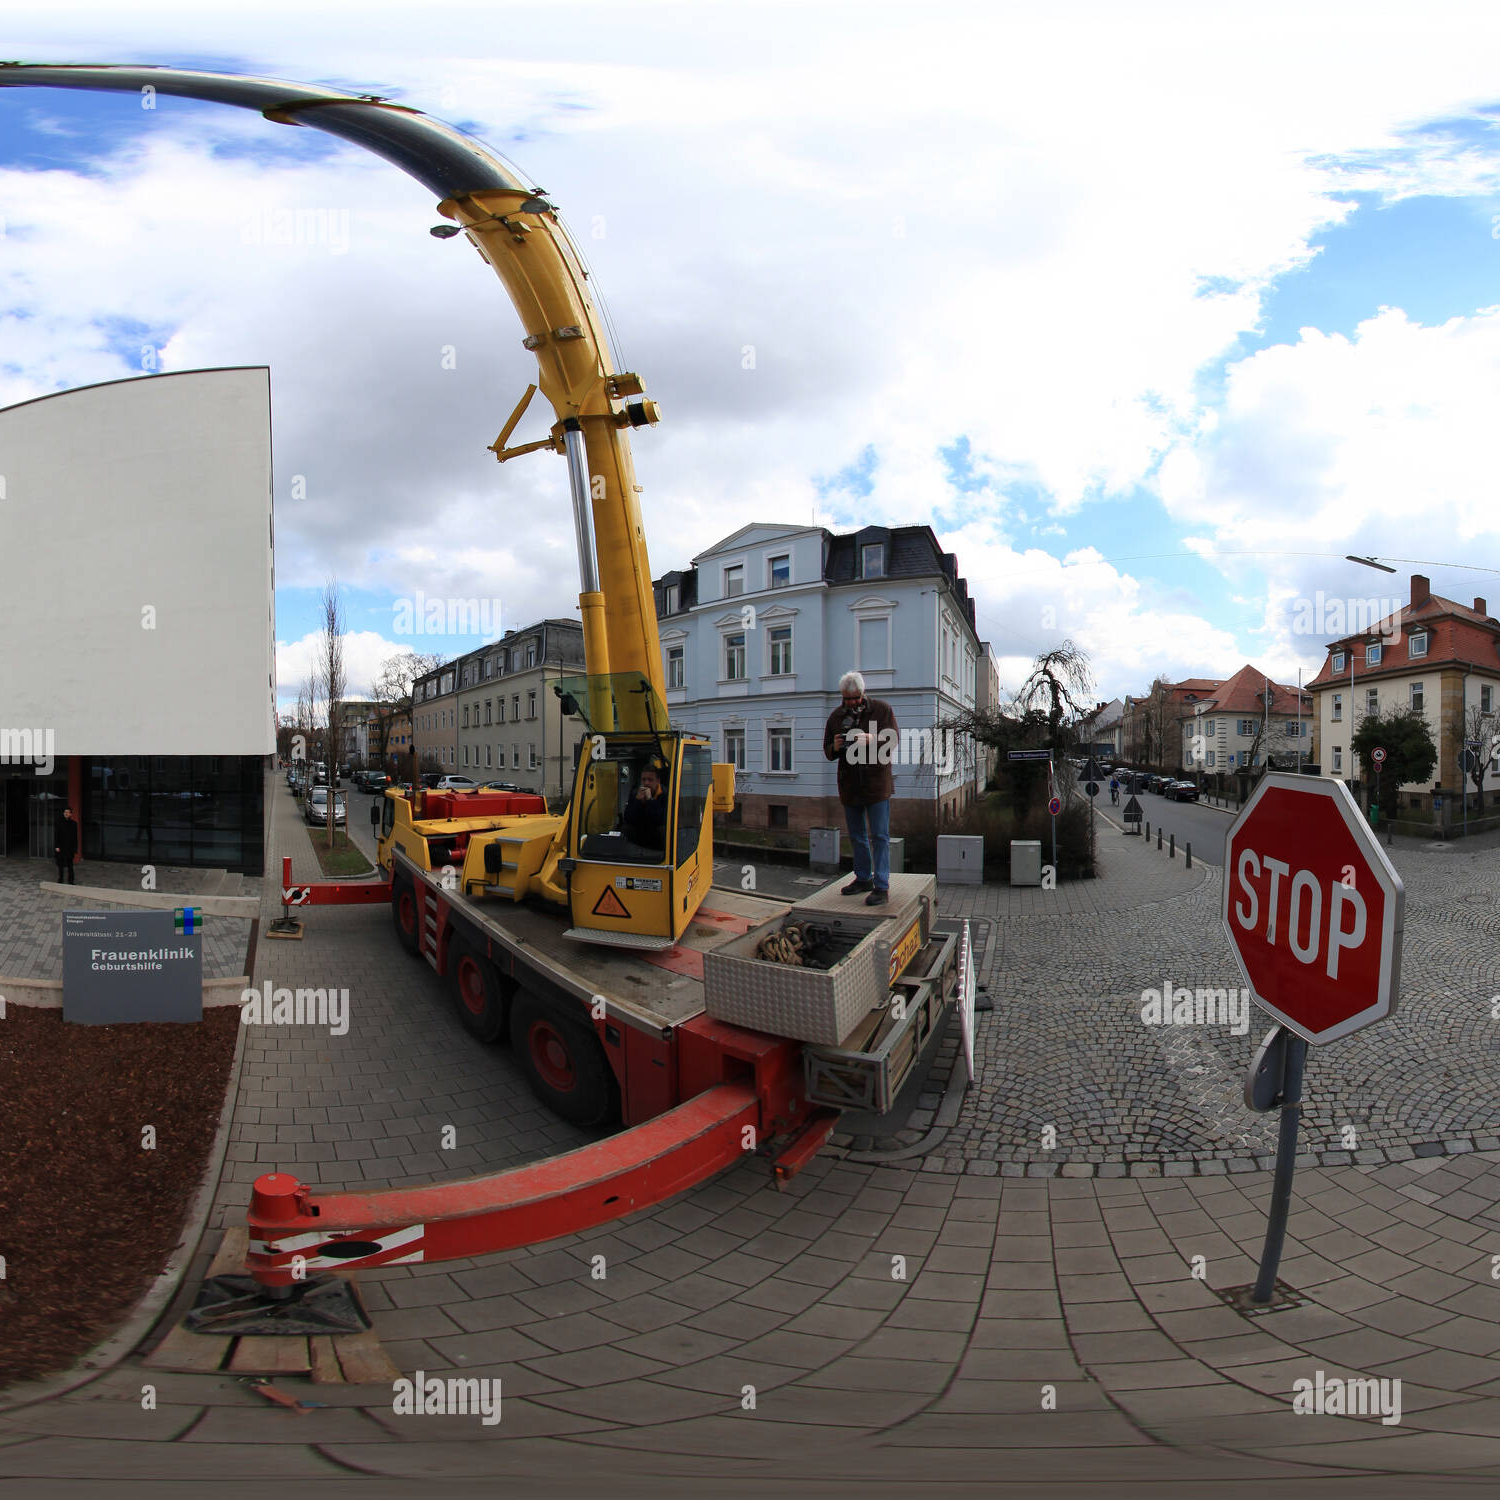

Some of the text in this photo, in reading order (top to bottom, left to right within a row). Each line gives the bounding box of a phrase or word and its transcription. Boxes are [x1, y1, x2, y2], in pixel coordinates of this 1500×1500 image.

[1235, 848, 1367, 980] STOP
[91, 947, 195, 961] Frauenklinik
[91, 962, 163, 971] Geburtshilfe
